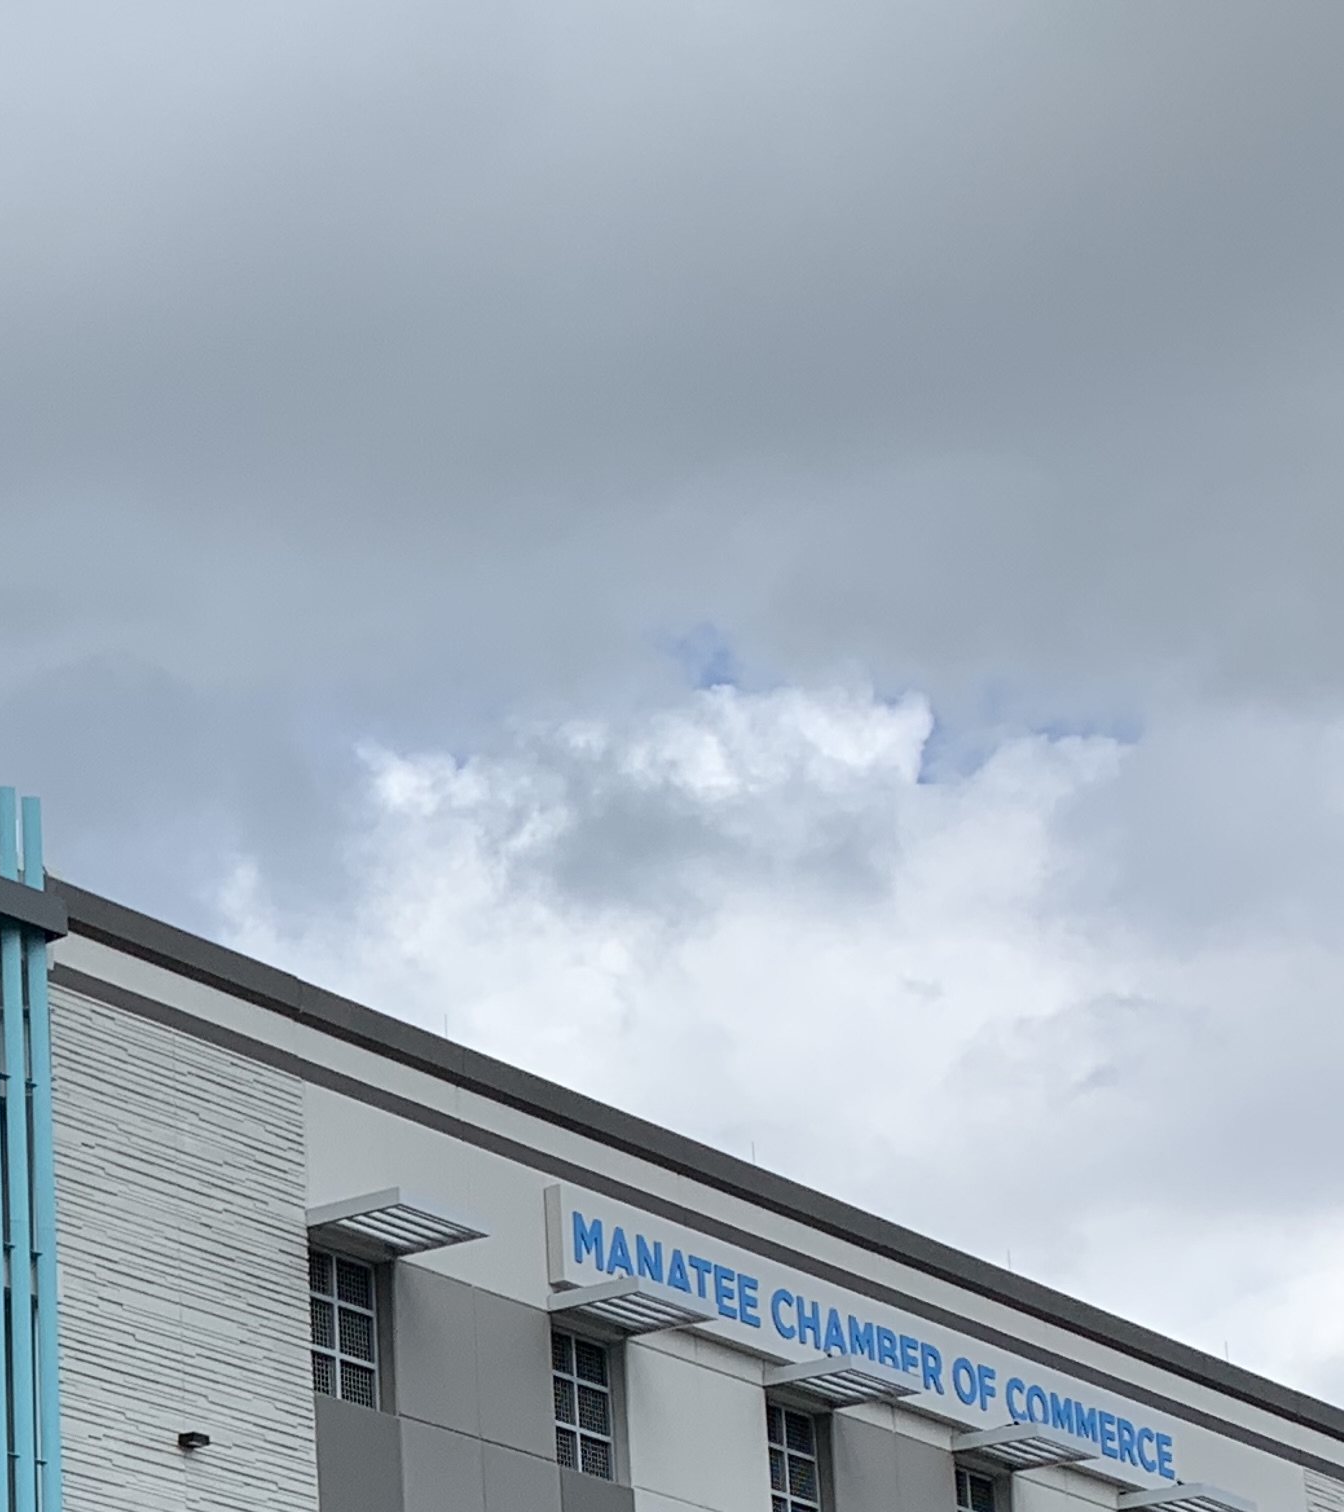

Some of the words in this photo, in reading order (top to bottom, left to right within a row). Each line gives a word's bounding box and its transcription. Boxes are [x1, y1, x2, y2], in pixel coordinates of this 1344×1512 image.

[572, 1210, 761, 1329] MANATEE
[770, 1288, 945, 1396] CHAMBER
[952, 1356, 997, 1412] OF
[1005, 1377, 1176, 1481] COMMERCE
